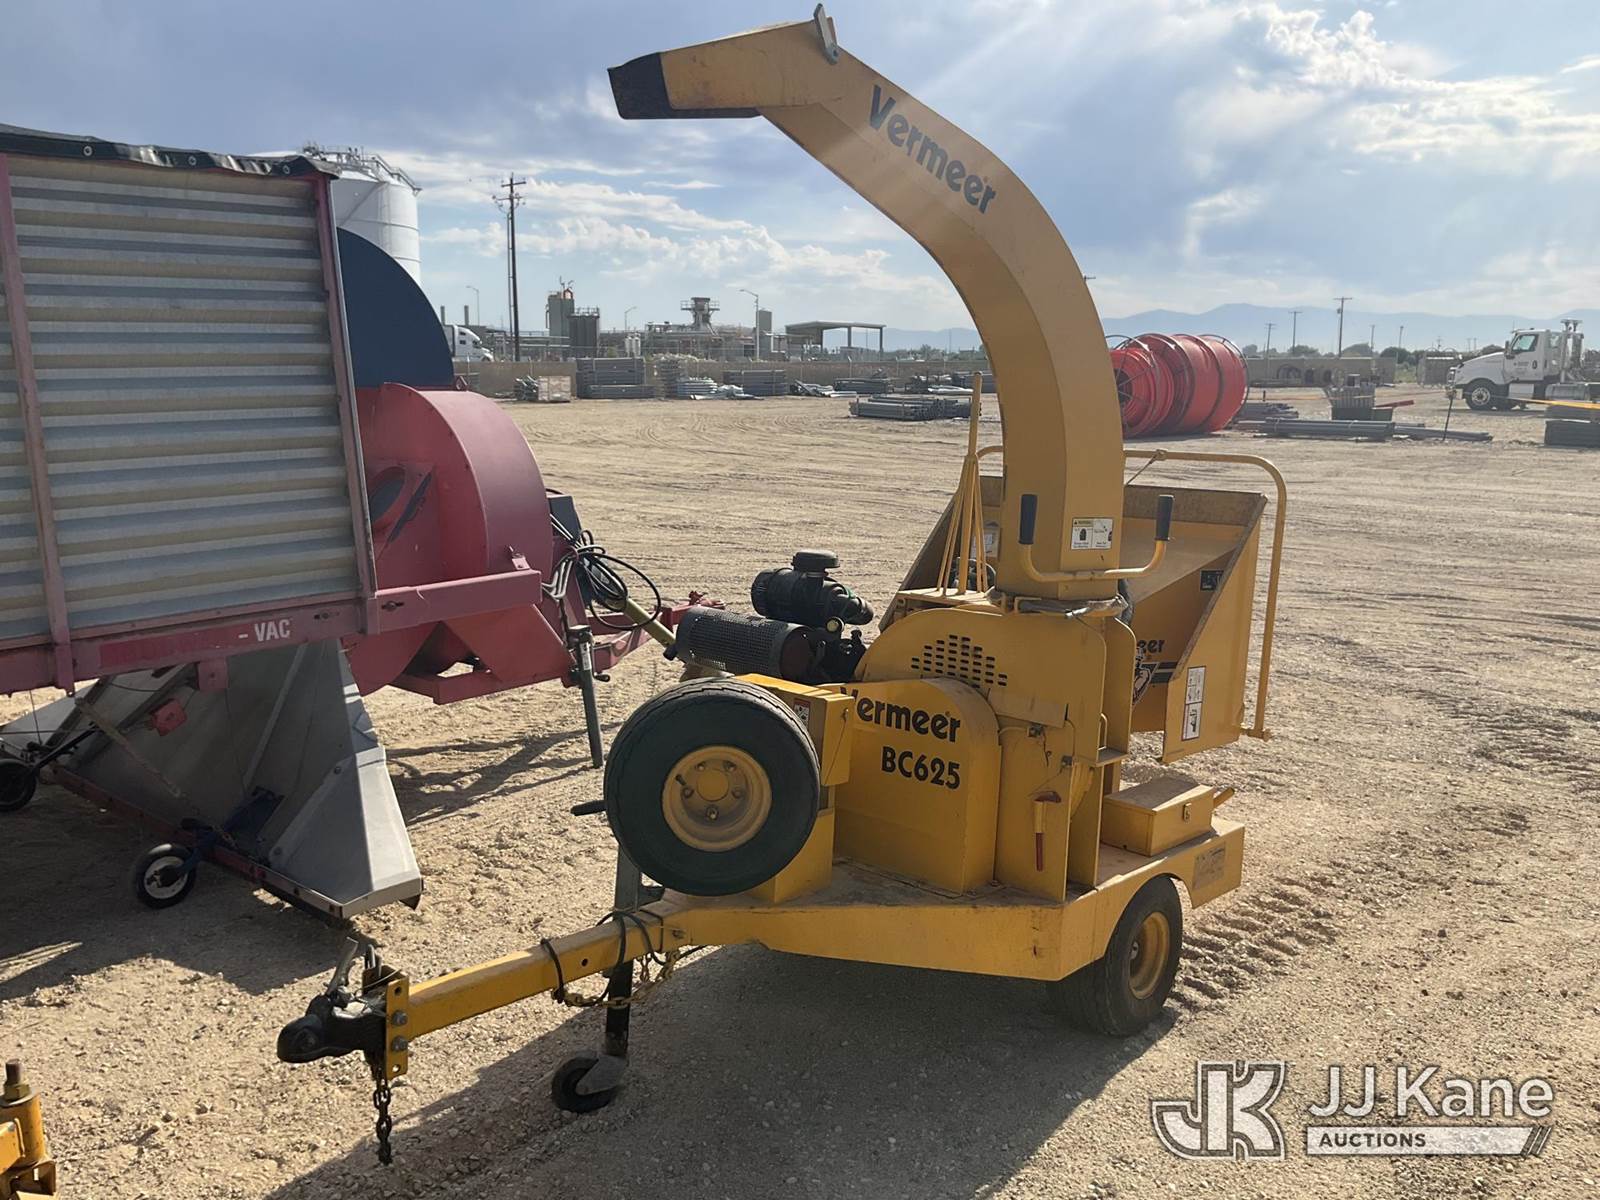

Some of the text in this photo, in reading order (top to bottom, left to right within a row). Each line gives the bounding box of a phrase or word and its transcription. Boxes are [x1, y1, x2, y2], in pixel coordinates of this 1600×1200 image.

[870, 84, 996, 214] Vermeer
[254, 619, 290, 642] VAC
[881, 746, 960, 789] BC625
